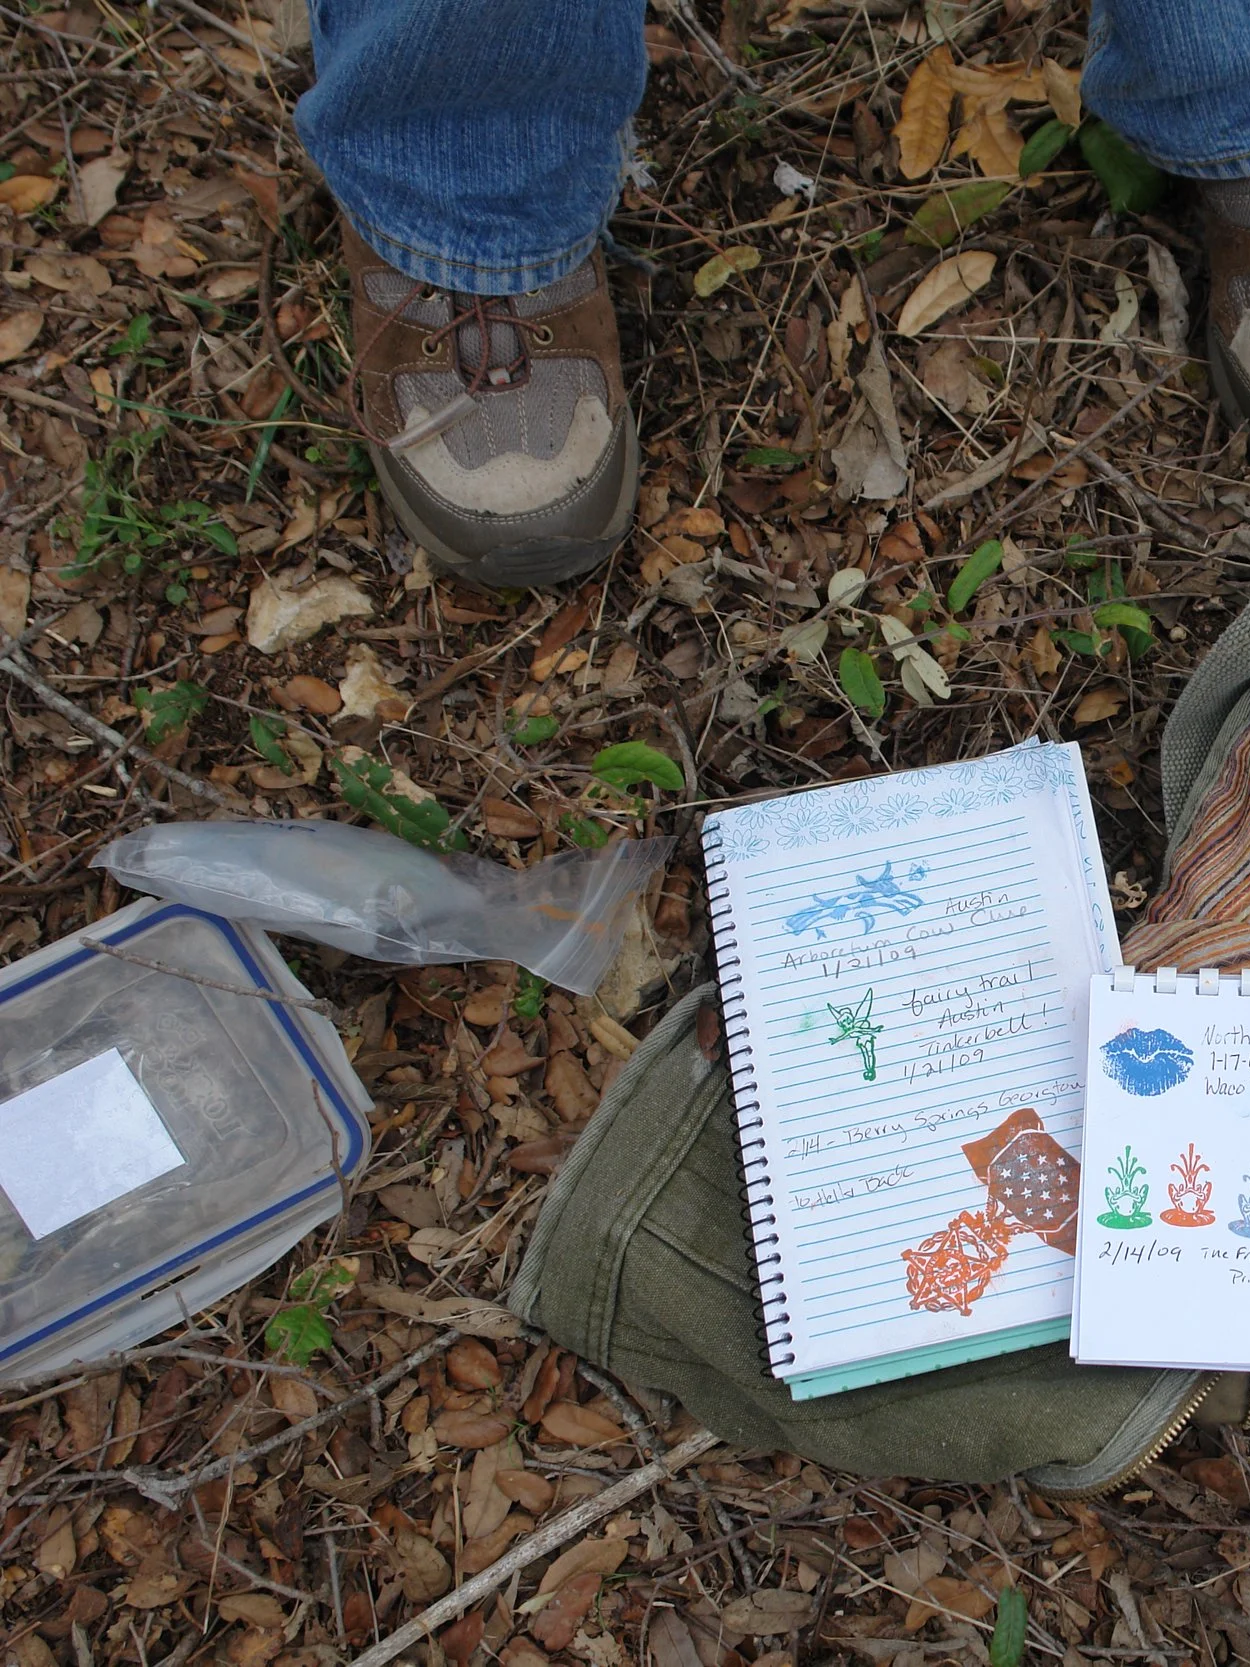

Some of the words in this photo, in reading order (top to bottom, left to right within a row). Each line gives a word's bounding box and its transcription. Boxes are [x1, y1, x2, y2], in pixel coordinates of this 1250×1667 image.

[945, 891, 1010, 916] Austin
[780, 938, 892, 971] Arboretum
[906, 922, 954, 942] Cow
[822, 944, 918, 979] 1/21/09
[902, 988, 974, 1017] fairy
[978, 960, 1034, 992] trail
[937, 998, 1004, 1029] Austin
[903, 1048, 984, 1085] 1/21/09
[1204, 1076, 1246, 1096] Waco
[842, 1123, 908, 1146] Berry
[914, 1101, 989, 1132] Springs
[1098, 1239, 1183, 1266] 2/14/09
